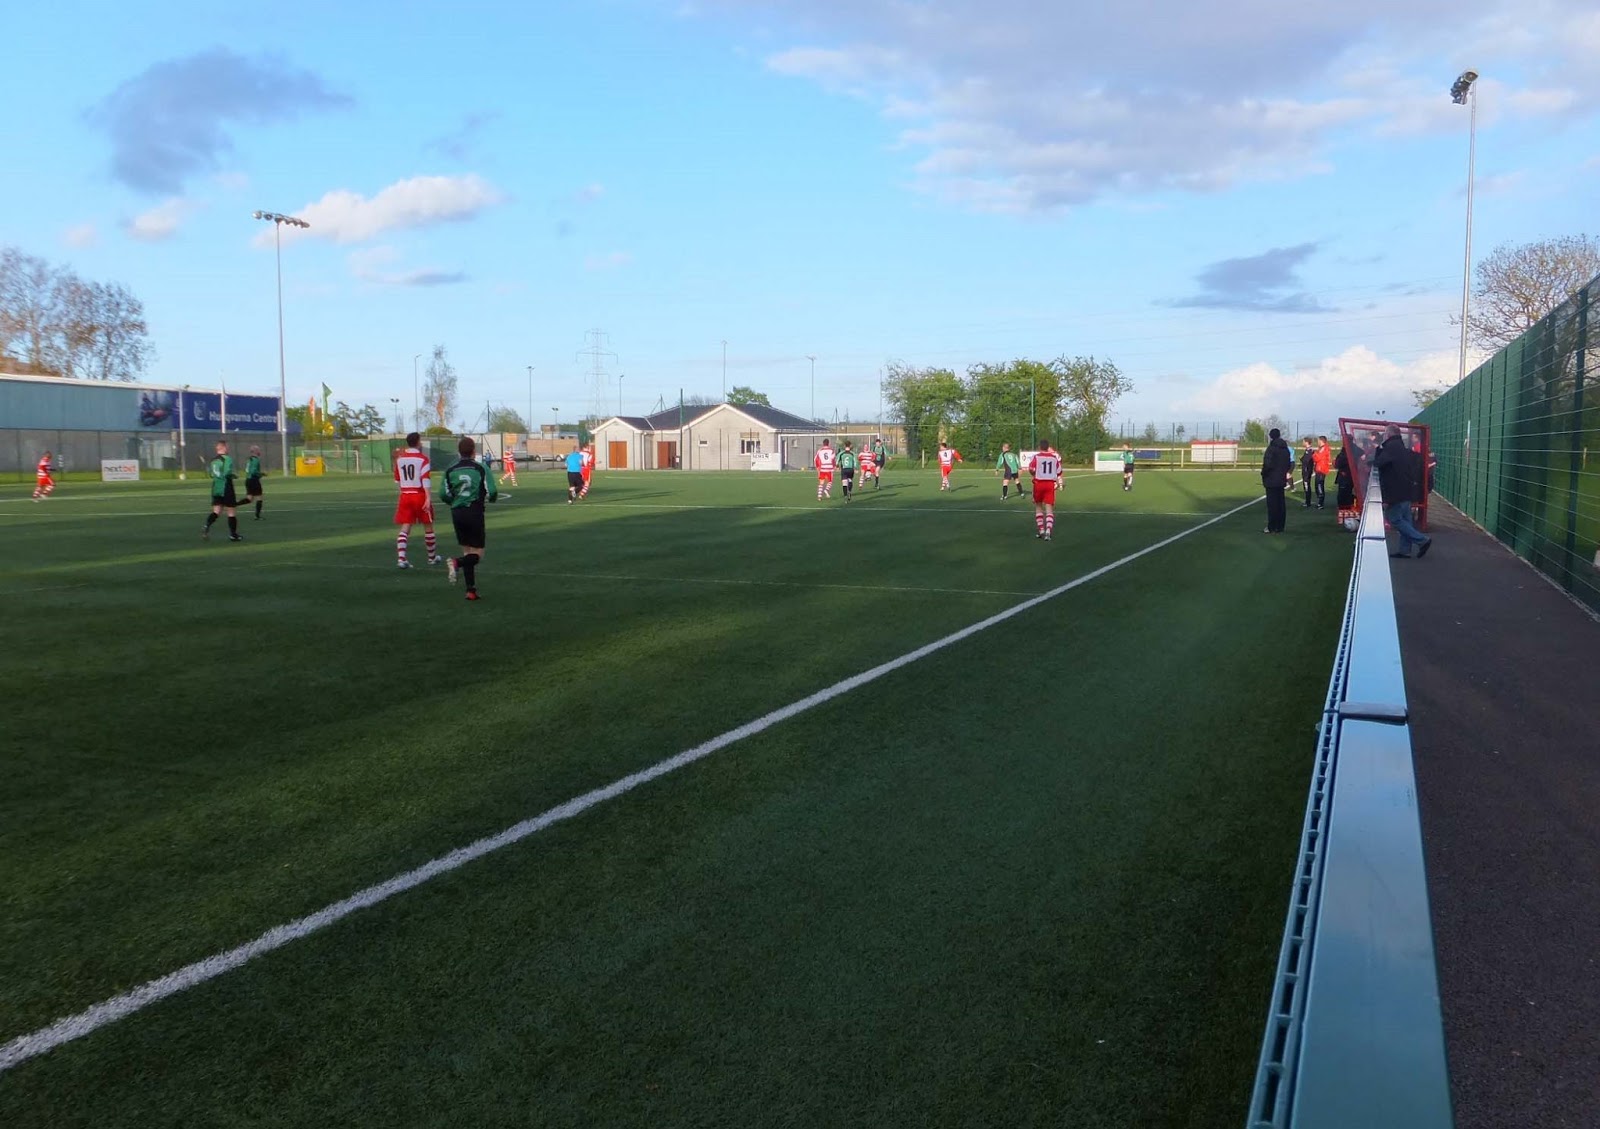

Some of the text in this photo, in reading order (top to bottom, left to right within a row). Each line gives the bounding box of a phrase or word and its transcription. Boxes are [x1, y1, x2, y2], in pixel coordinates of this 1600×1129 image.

[401, 463, 415, 481] 10
[1042, 461, 1053, 474] 11
[459, 474, 472, 497] 2
